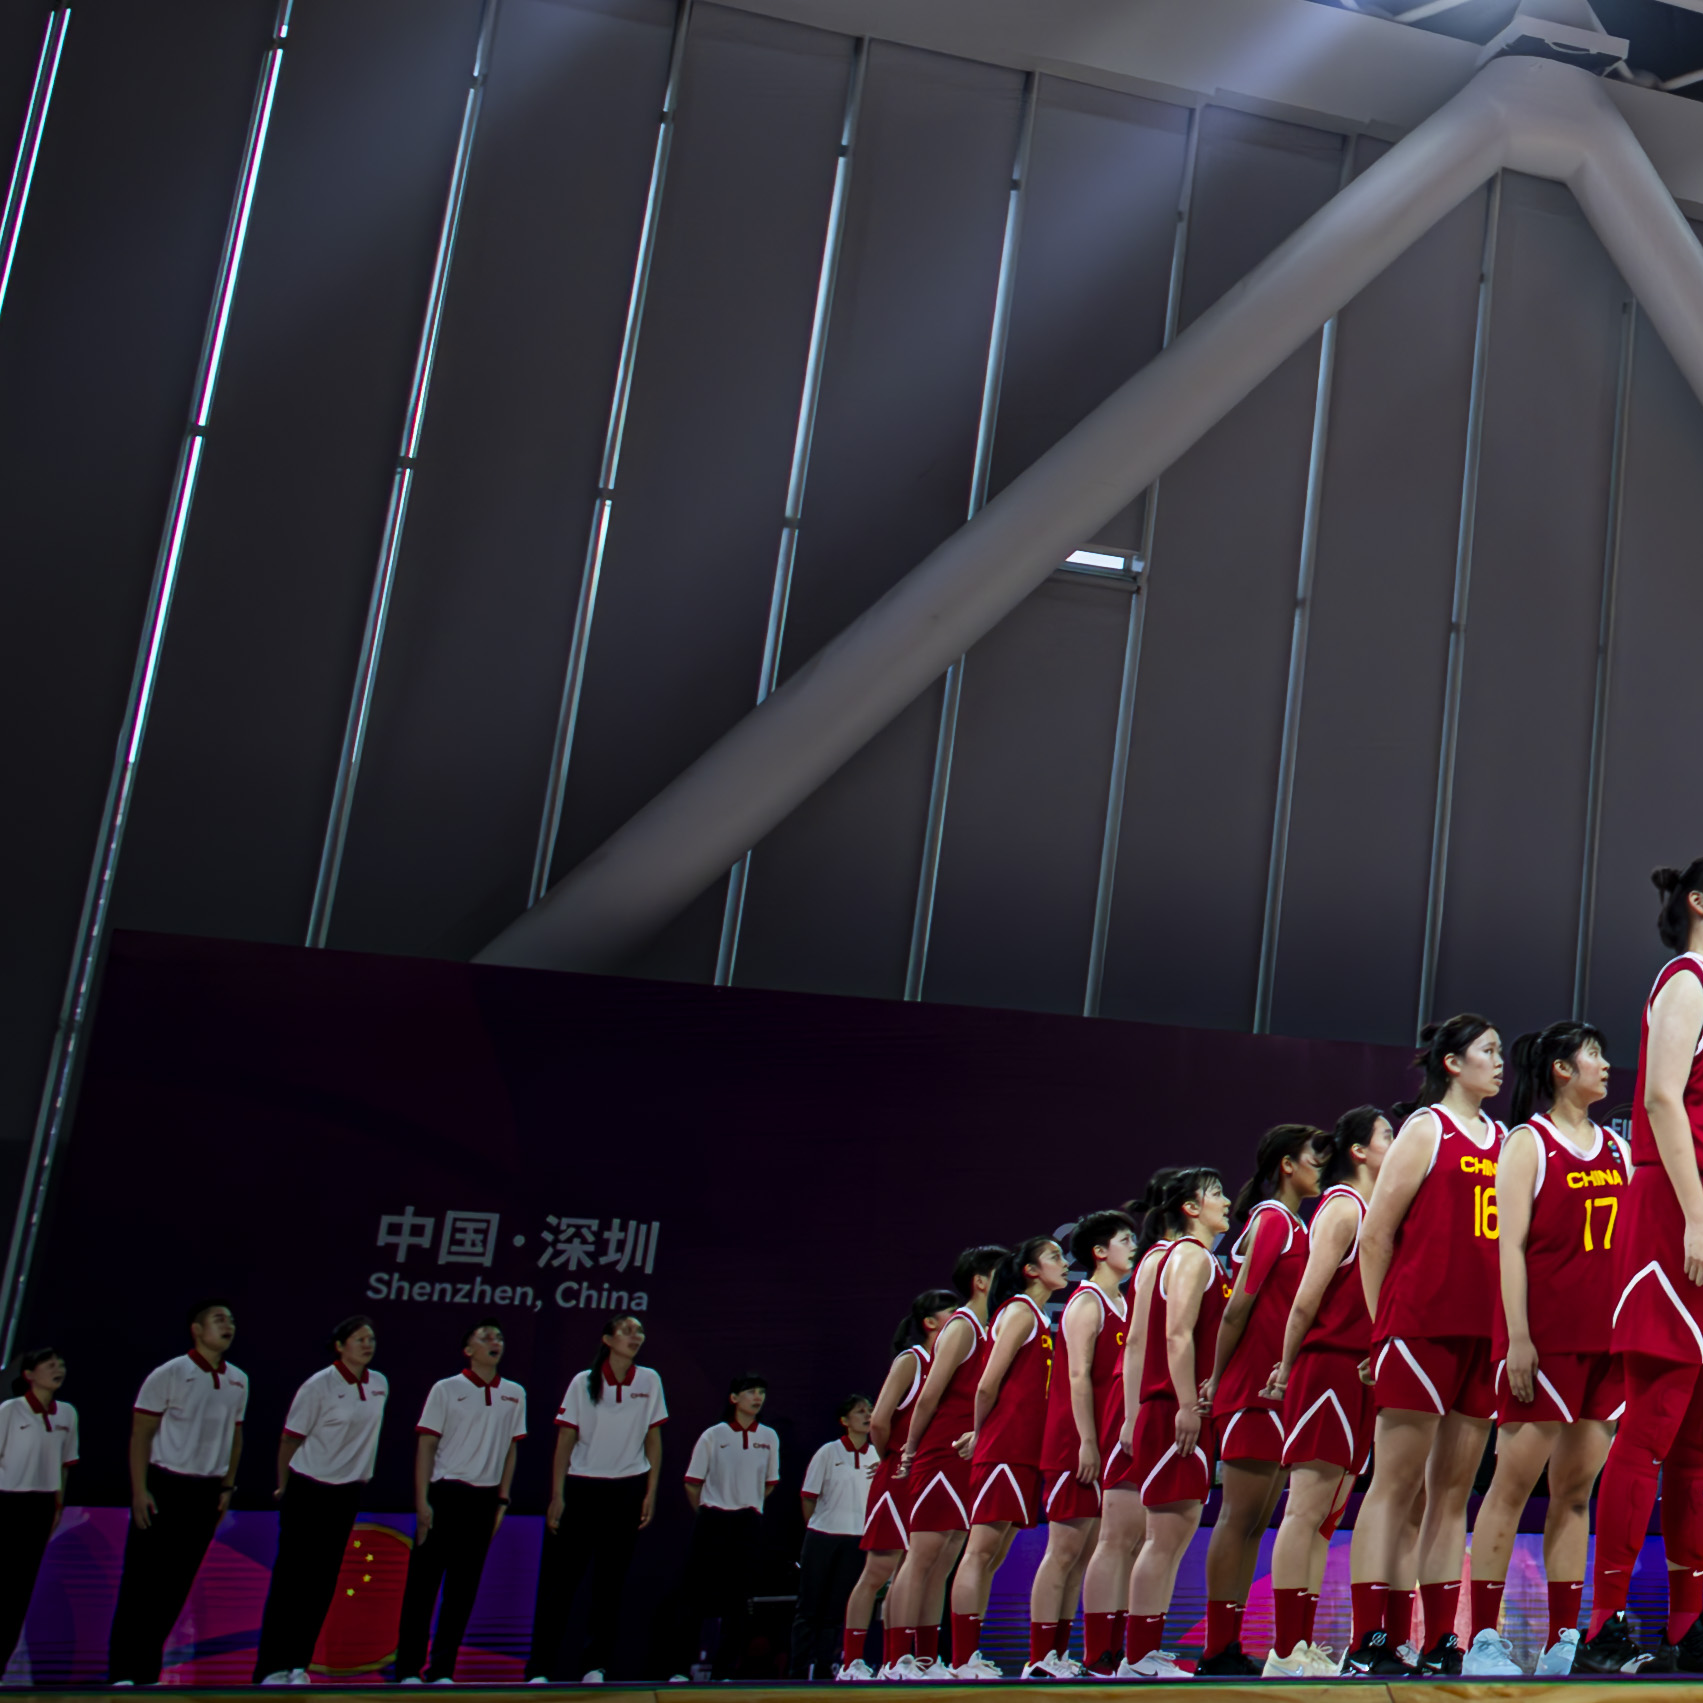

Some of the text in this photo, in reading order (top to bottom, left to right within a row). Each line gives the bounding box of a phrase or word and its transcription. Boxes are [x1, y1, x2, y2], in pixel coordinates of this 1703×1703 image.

[1460, 1156, 1497, 1177] CHIN
[1566, 1169, 1623, 1189] CHINA
[1474, 1185, 1499, 1240] 16
[1584, 1196, 1618, 1252] 17
[366, 1271, 650, 1313] Shenzhen, China
